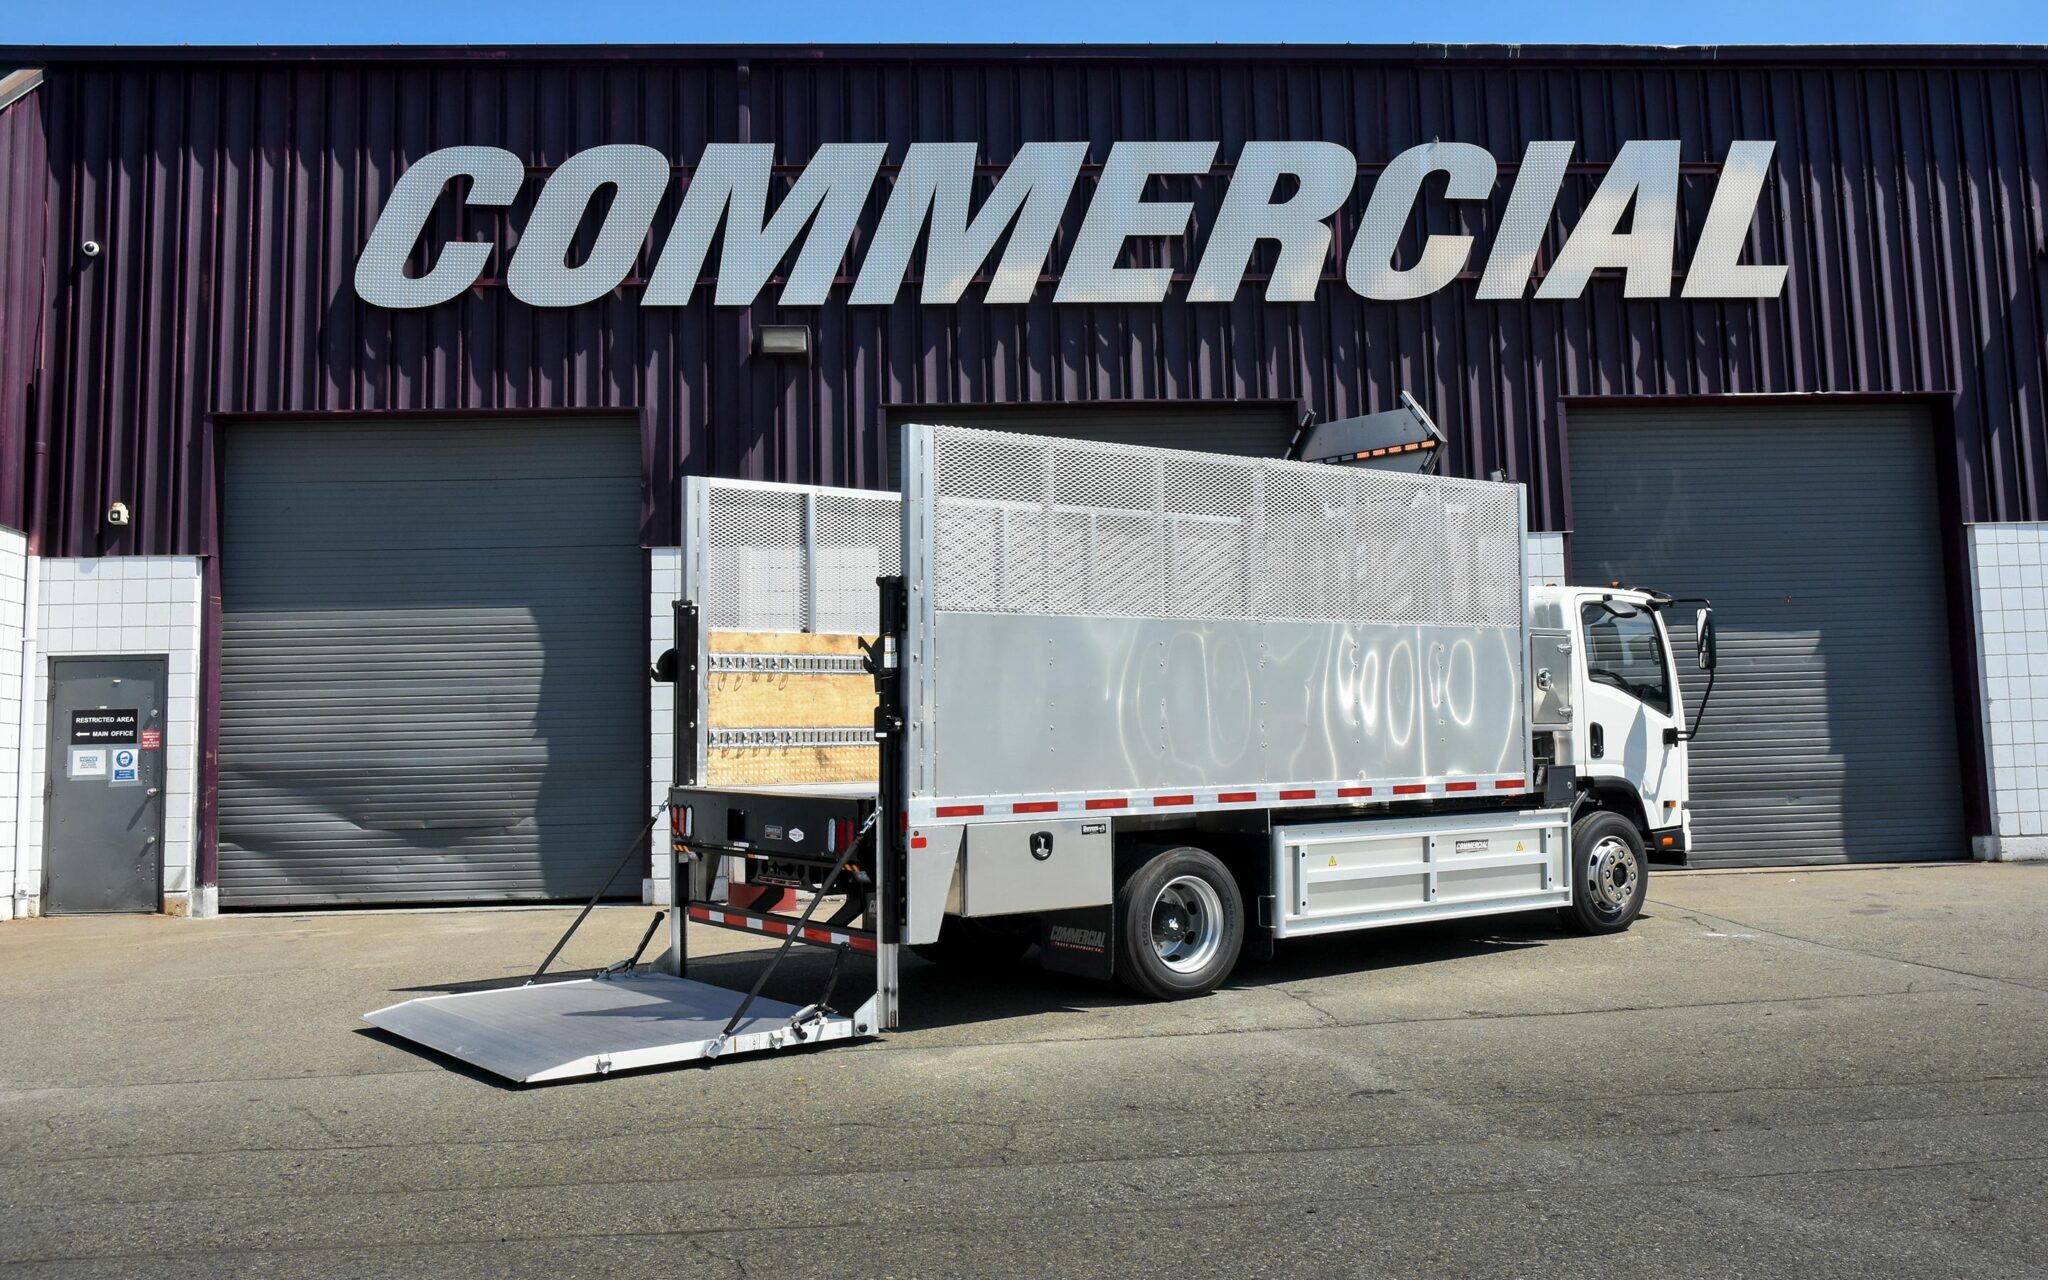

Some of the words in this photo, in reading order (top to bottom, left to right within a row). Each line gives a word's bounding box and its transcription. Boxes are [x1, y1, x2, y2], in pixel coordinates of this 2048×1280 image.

[353, 138, 1789, 310] COMMERCIAL
[1456, 841, 1487, 849] COMMERCIAL
[1050, 926, 1106, 947] COMMERCIAL
